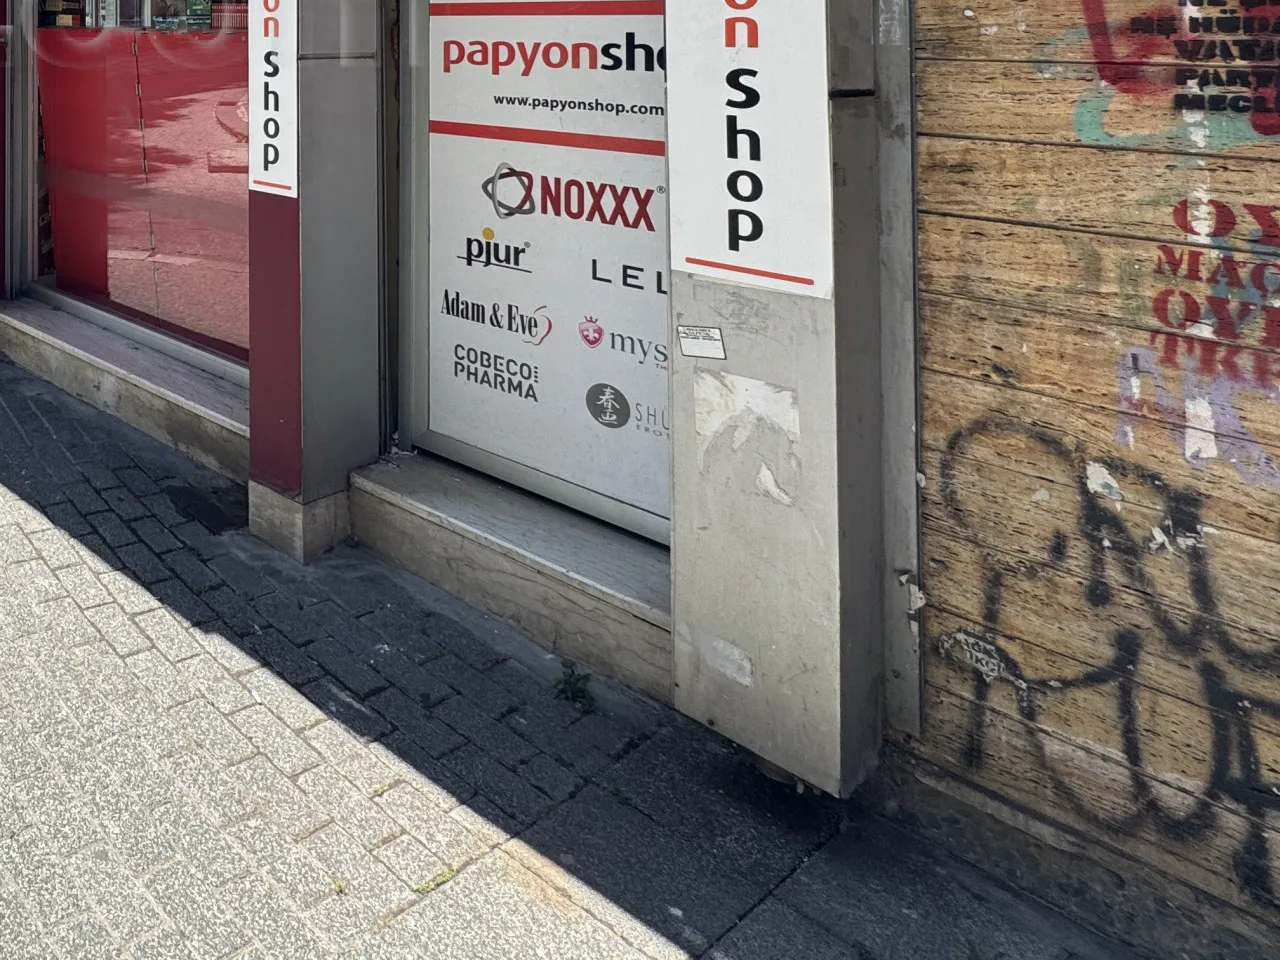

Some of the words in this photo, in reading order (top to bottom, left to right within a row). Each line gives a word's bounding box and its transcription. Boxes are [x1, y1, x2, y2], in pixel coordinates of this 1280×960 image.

[493, 94, 664, 116] www.papyonshop.com
[541, 176, 656, 232] NOXXX
[466, 228, 526, 268] pjur
[440, 288, 486, 325] Adam
[489, 304, 504, 328] &
[507, 305, 538, 338] Eve
[454, 343, 533, 380] COBECO
[609, 332, 668, 364] mys
[454, 363, 539, 403] PHARMA
[636, 424, 670, 438] ERO
